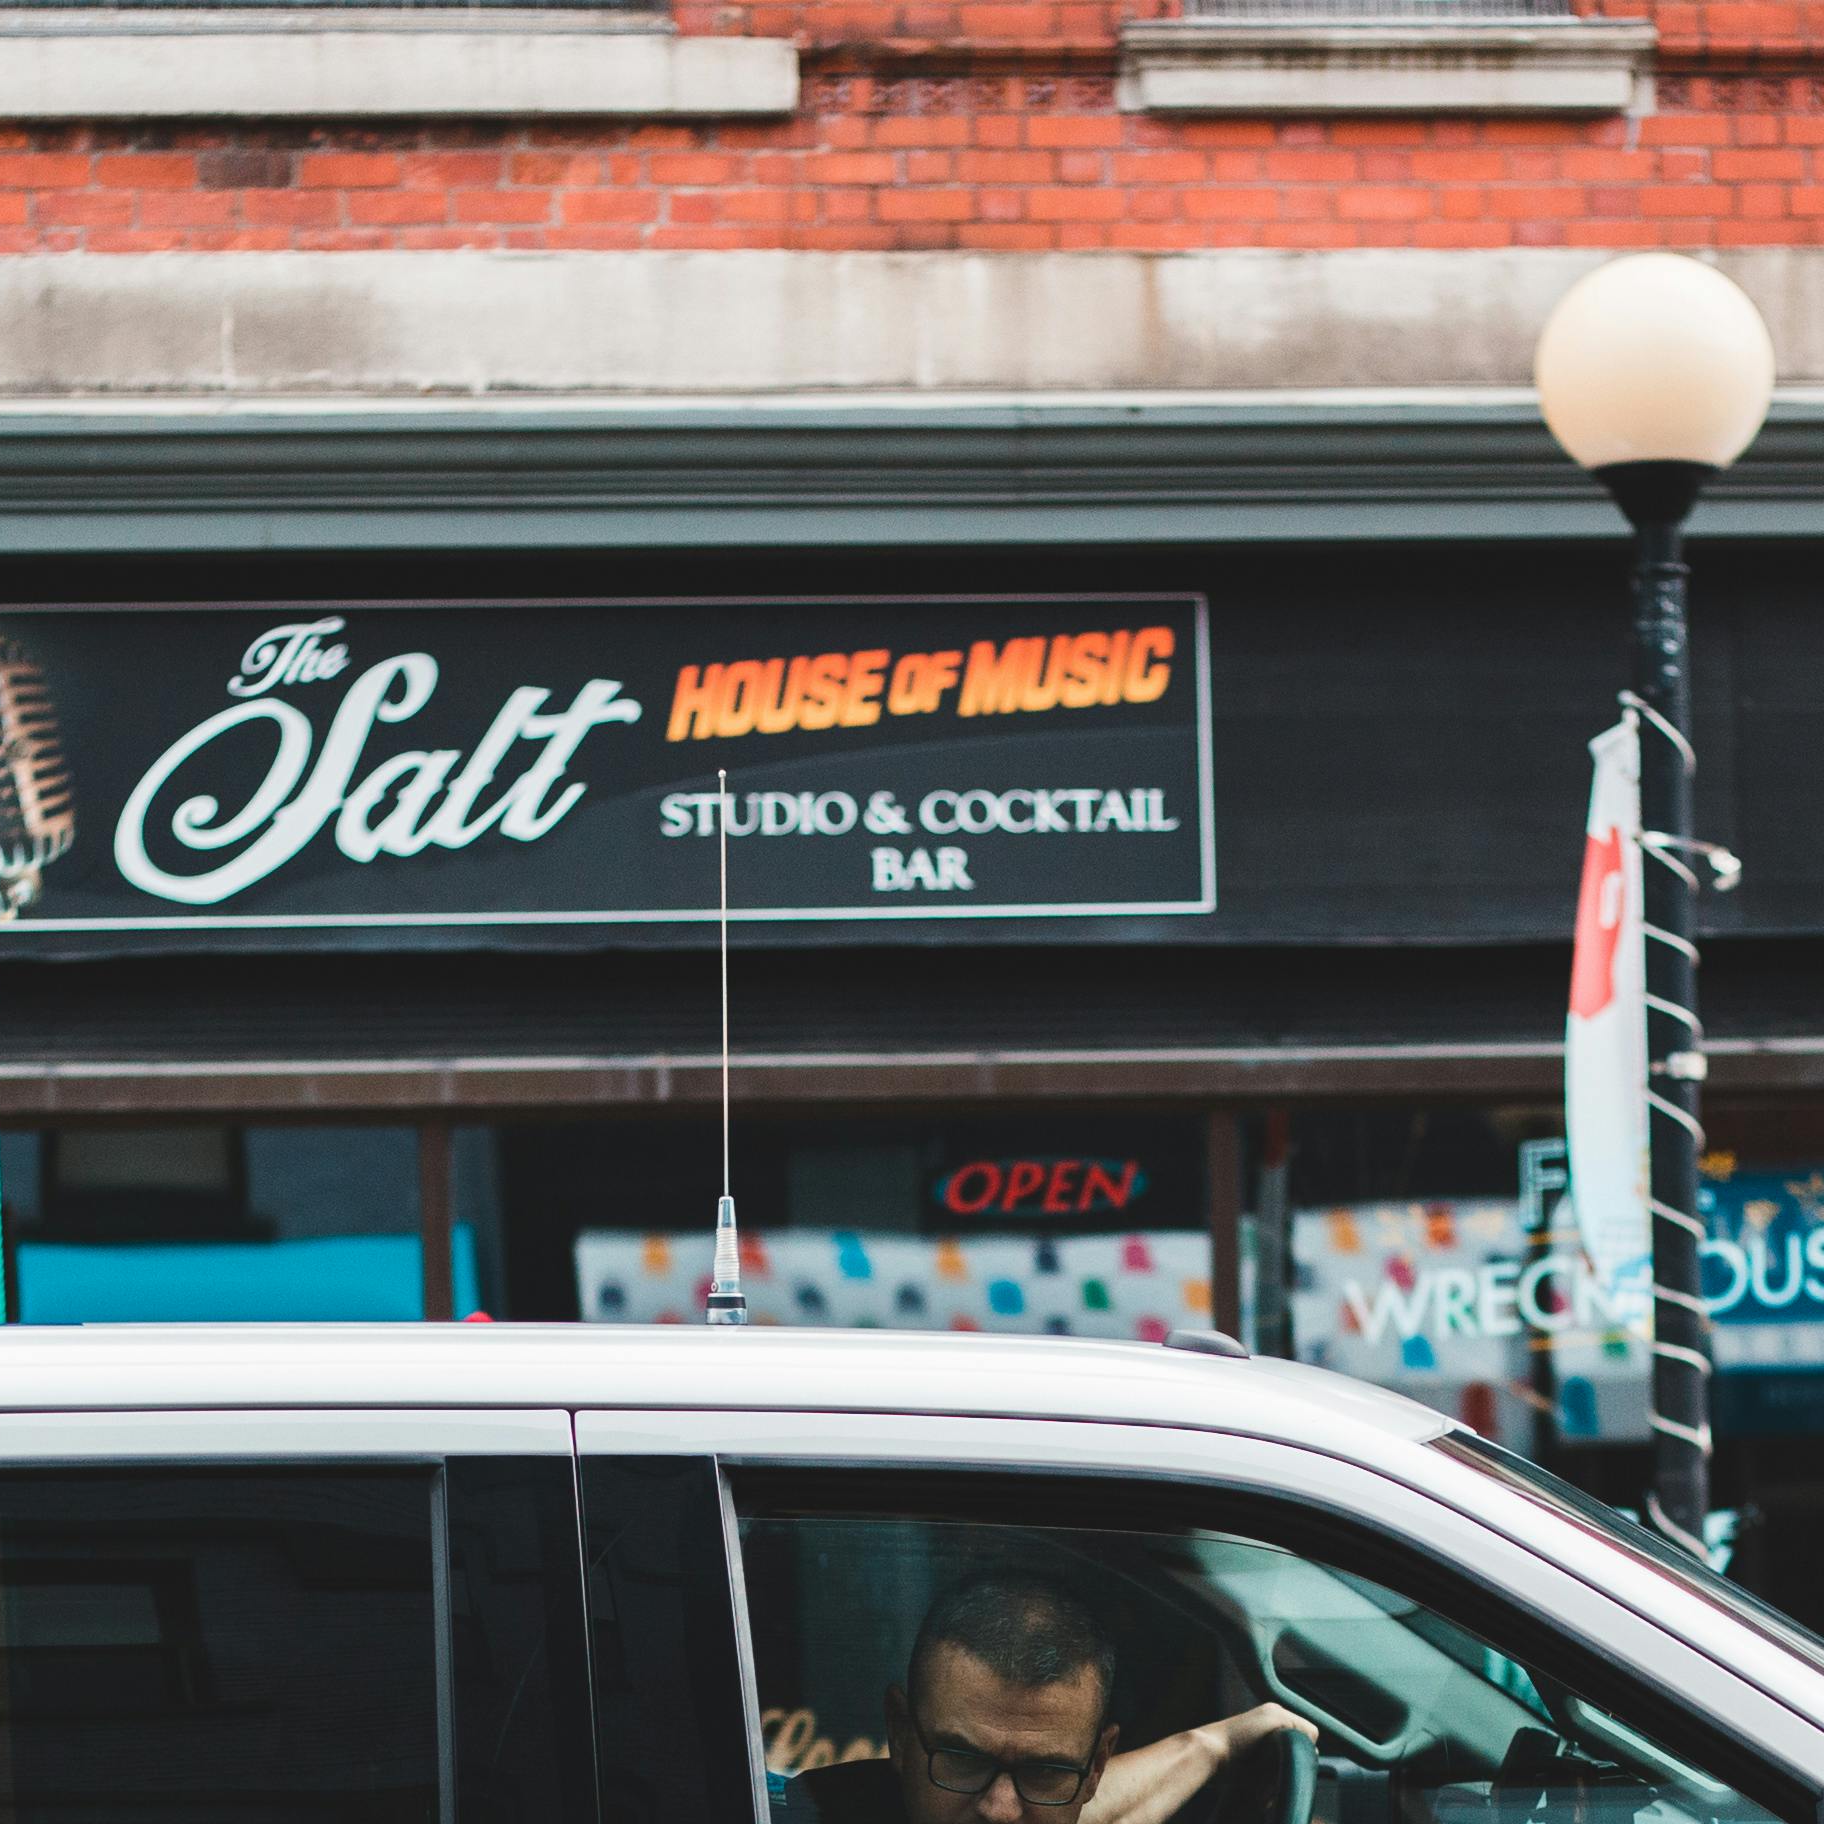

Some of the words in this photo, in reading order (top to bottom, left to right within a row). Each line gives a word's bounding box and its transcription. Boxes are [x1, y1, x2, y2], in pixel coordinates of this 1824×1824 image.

[227, 617, 350, 697] The
[666, 649, 891, 742] HOUSE
[888, 651, 963, 716] OF
[956, 627, 1174, 717] MUSIC
[114, 652, 642, 904] Salt
[660, 791, 858, 837] STUDIO
[863, 790, 912, 834] &
[919, 788, 1180, 835] COCKTAIL
[872, 847, 974, 892] BAR
[944, 1159, 1138, 1213] OPEN
